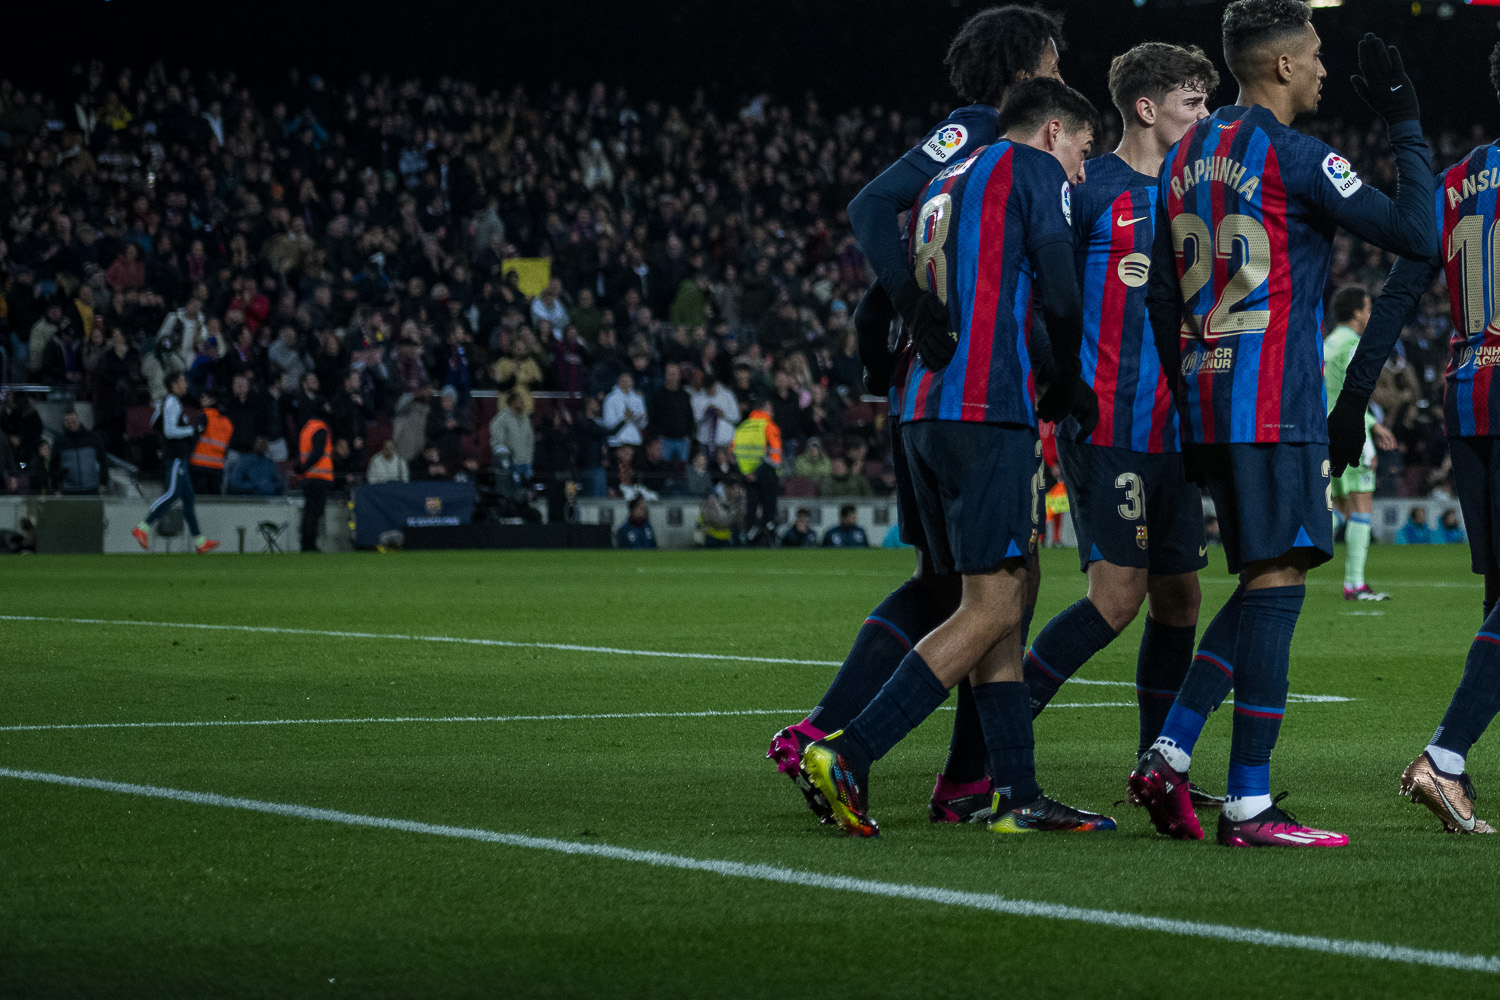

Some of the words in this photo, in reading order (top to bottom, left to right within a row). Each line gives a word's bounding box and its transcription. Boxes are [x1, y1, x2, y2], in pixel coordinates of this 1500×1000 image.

[927, 140, 947, 160] LaLiga
[1170, 155, 1261, 202] RAPHINHA
[914, 192, 953, 307] 8
[1170, 212, 1272, 340] 22
